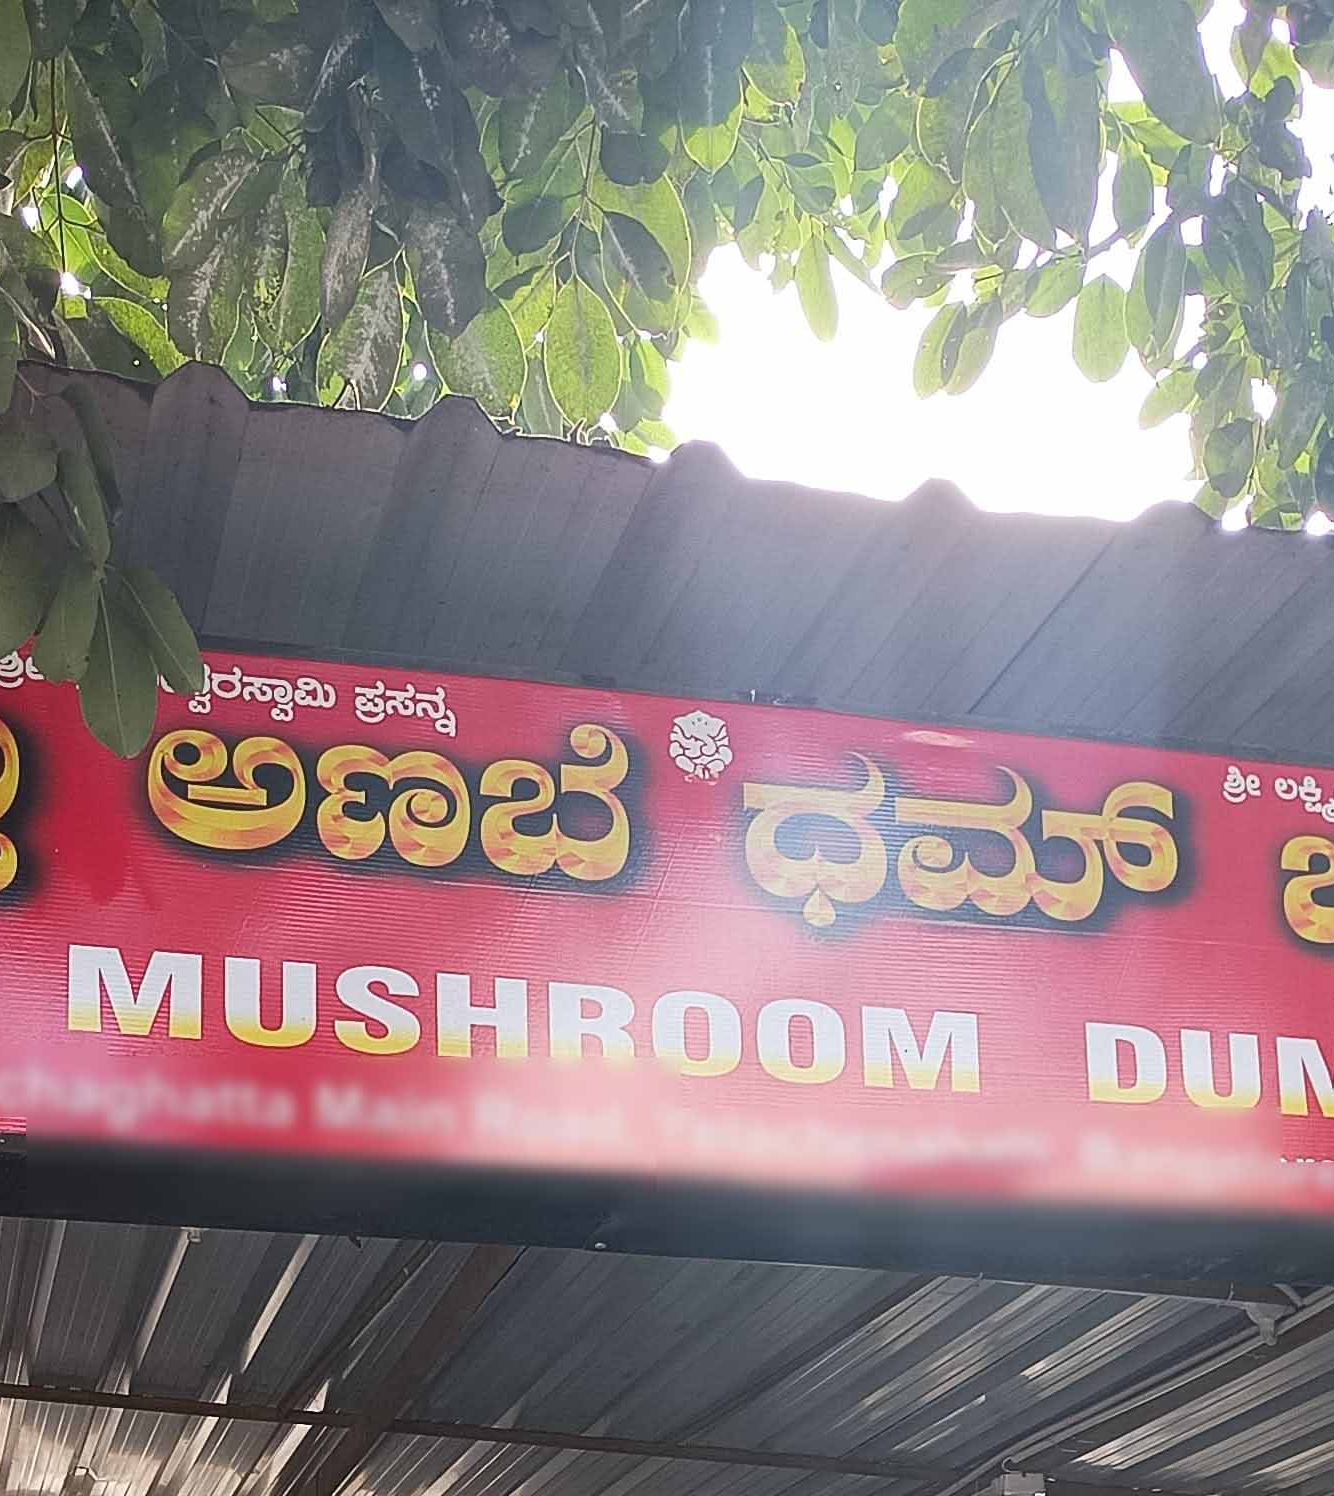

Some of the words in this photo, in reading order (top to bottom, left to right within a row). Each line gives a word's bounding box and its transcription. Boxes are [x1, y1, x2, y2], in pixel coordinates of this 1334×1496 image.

[354, 681, 457, 737] ಪ್ರಸನ್ನ
[147, 723, 632, 881] ಅಣಬೆ
[743, 751, 1178, 926] ಧಮ್
[1223, 766, 1261, 802] ಶ್ರೀ
[68, 943, 981, 1094] MUSHROOM
